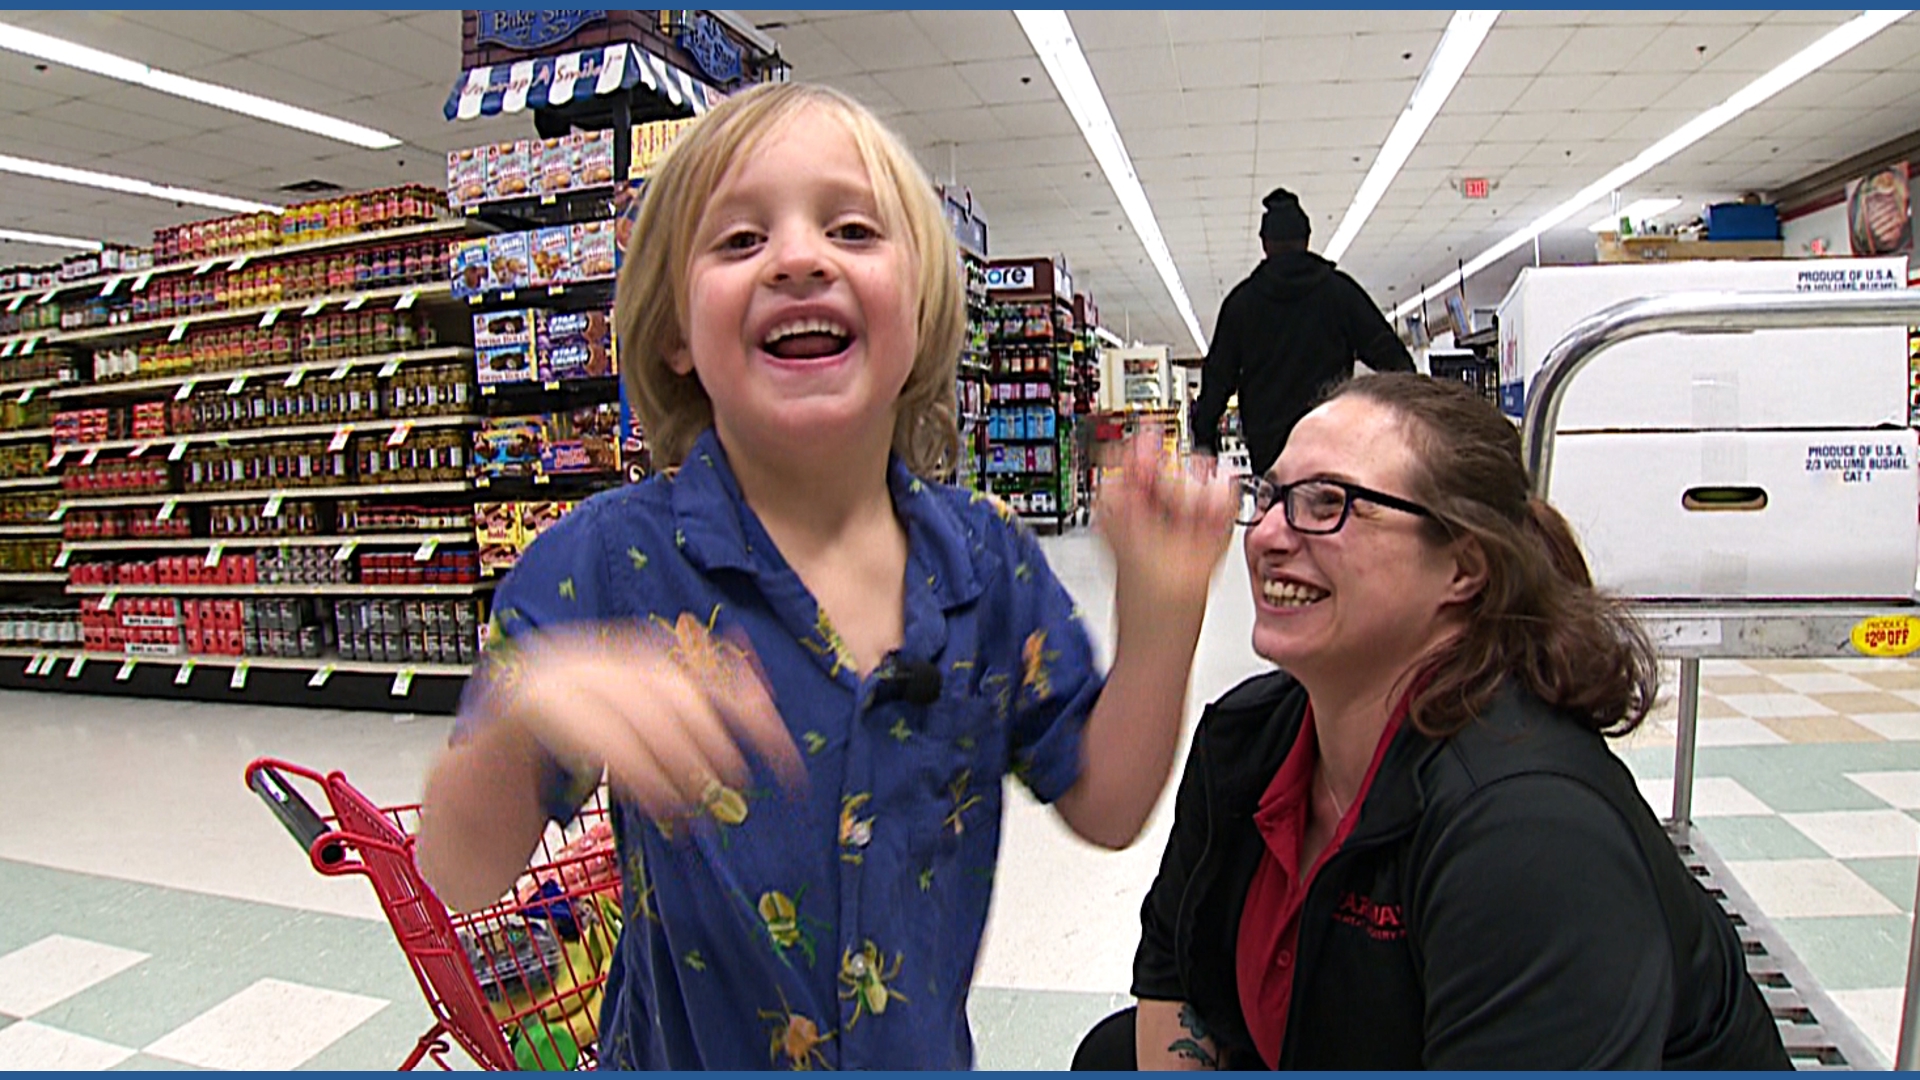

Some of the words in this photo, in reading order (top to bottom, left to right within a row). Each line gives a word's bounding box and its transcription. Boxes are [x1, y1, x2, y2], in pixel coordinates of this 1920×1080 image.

[494, 11, 536, 31] Bake
[532, 64, 550, 87] A
[1464, 179, 1488, 198] EXIT
[1798, 270, 1846, 281] PRODUCE
[1849, 269, 1863, 280] OF
[1808, 445, 1855, 457] PRODUCE
[1859, 445, 1872, 457] OF
[1806, 459, 1821, 471] 2/3
[1824, 459, 1866, 470] VOLUME
[1869, 458, 1908, 470] BUSHEL
[1843, 471, 1862, 482] CAT
[1866, 471, 1871, 482] 1
[1887, 628, 1909, 646] OFF
